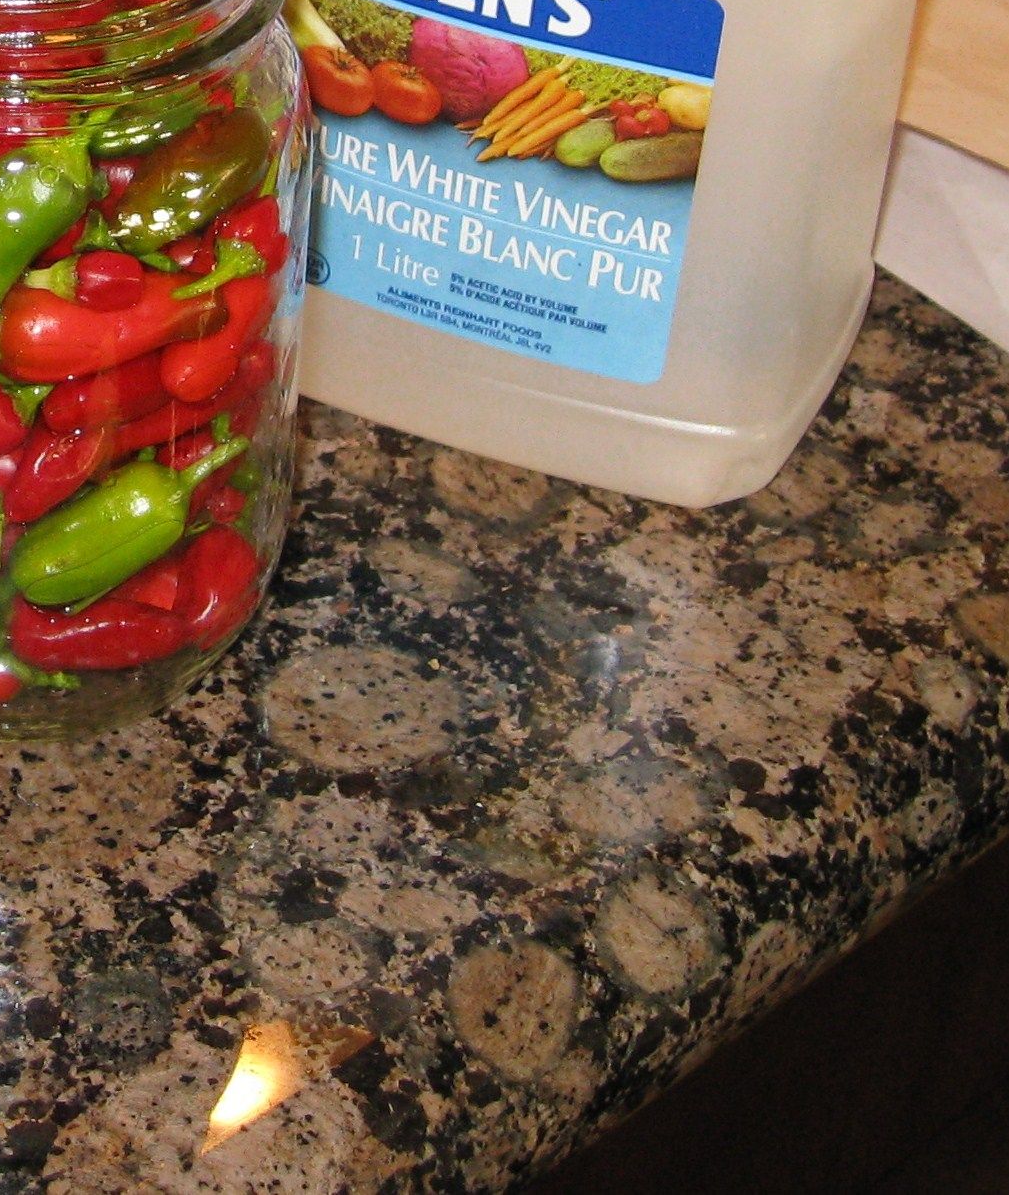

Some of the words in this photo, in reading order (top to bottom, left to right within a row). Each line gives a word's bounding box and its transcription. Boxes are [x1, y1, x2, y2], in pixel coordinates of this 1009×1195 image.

[315, 124, 380, 175] URE
[386, 142, 503, 214] WHITE
[512, 180, 673, 256] VINEGAR
[318, 172, 451, 247] INAIGRE
[457, 214, 578, 282] BLANC
[587, 249, 665, 303] PUR
[349, 234, 363, 260] 1
[376, 241, 440, 287] Litre
